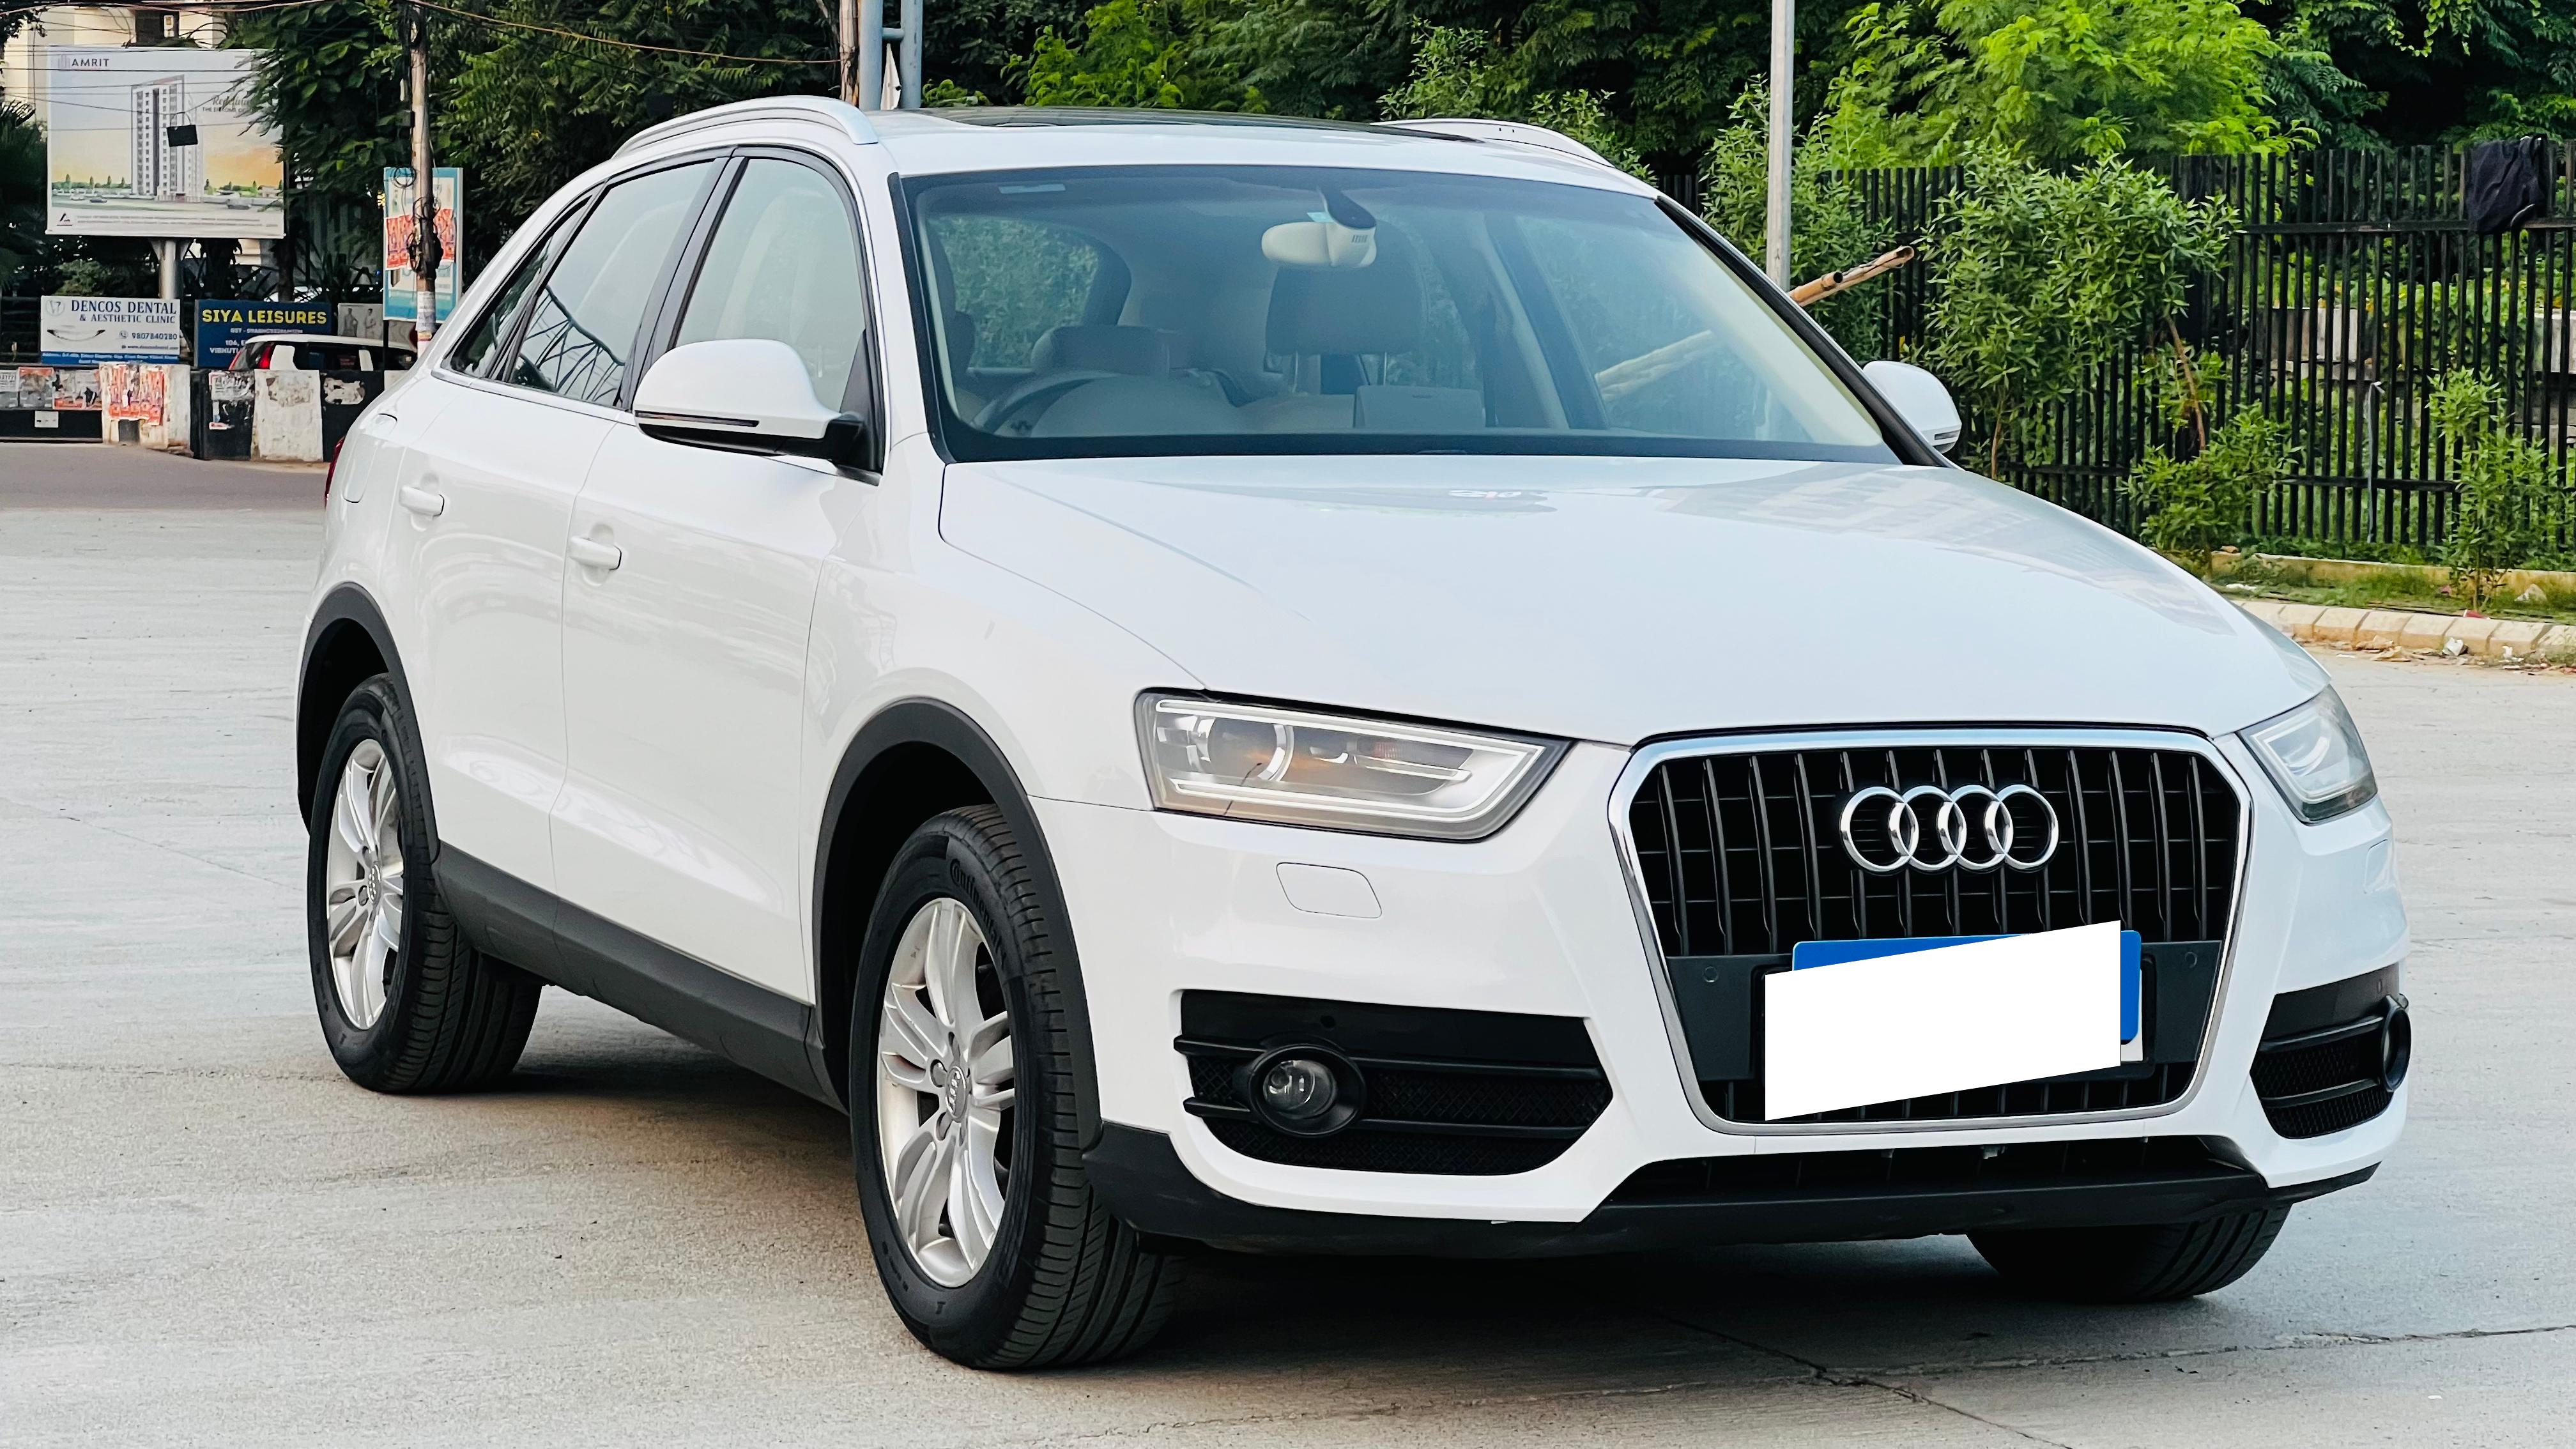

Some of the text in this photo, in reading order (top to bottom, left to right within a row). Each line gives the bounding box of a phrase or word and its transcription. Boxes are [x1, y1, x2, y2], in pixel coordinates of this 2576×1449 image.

[72, 58, 109, 67] AMRIT
[72, 300, 177, 314] DENCOS DENTAL
[91, 314, 142, 323] AESTHETIC
[146, 315, 176, 323] CLINIC
[202, 309, 327, 325] SIYA LEISURES
